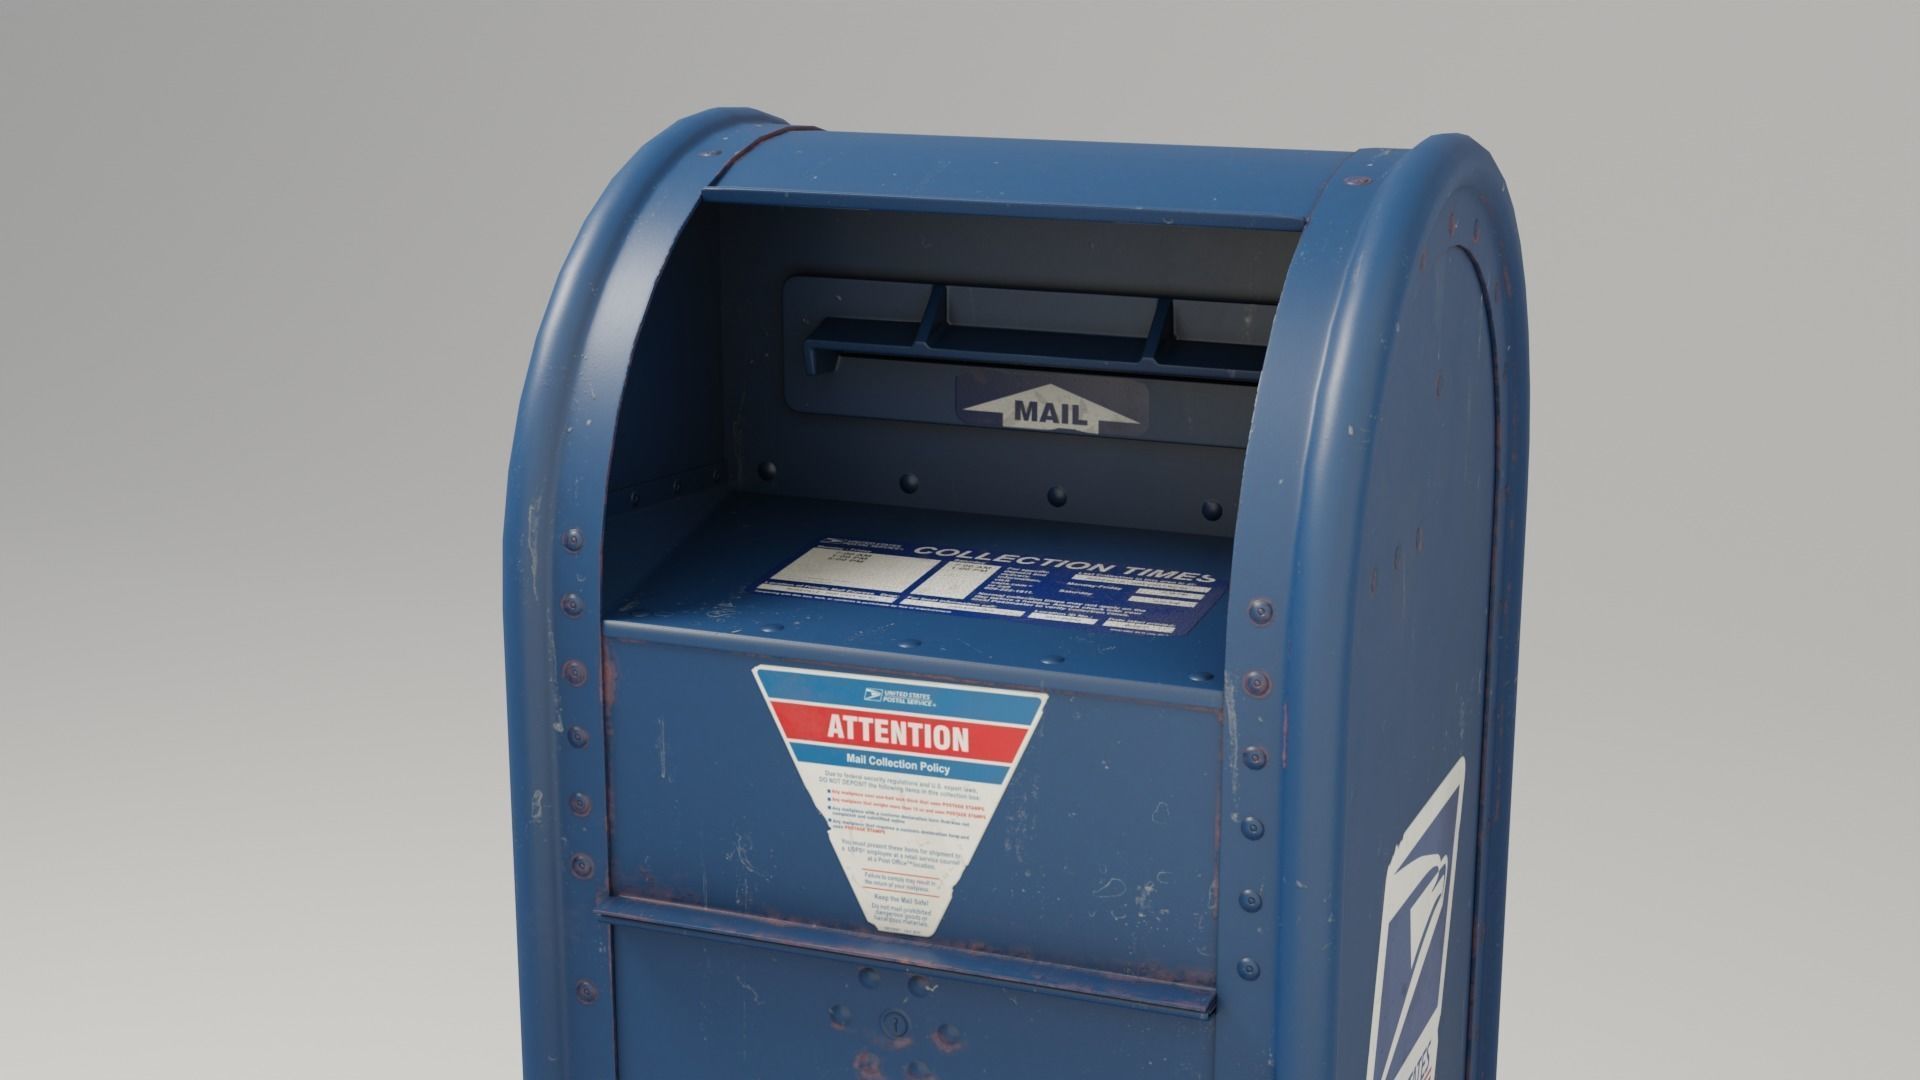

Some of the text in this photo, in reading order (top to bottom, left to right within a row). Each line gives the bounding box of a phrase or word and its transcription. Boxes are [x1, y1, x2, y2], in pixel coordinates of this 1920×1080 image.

[1014, 399, 1088, 426] MAIL
[913, 546, 1116, 574] COLLECTION
[1122, 565, 1218, 584] TIMES
[908, 692, 931, 700] STATES
[827, 713, 970, 752] ATTENTION
[846, 753, 950, 776] Mail Collection Policy
